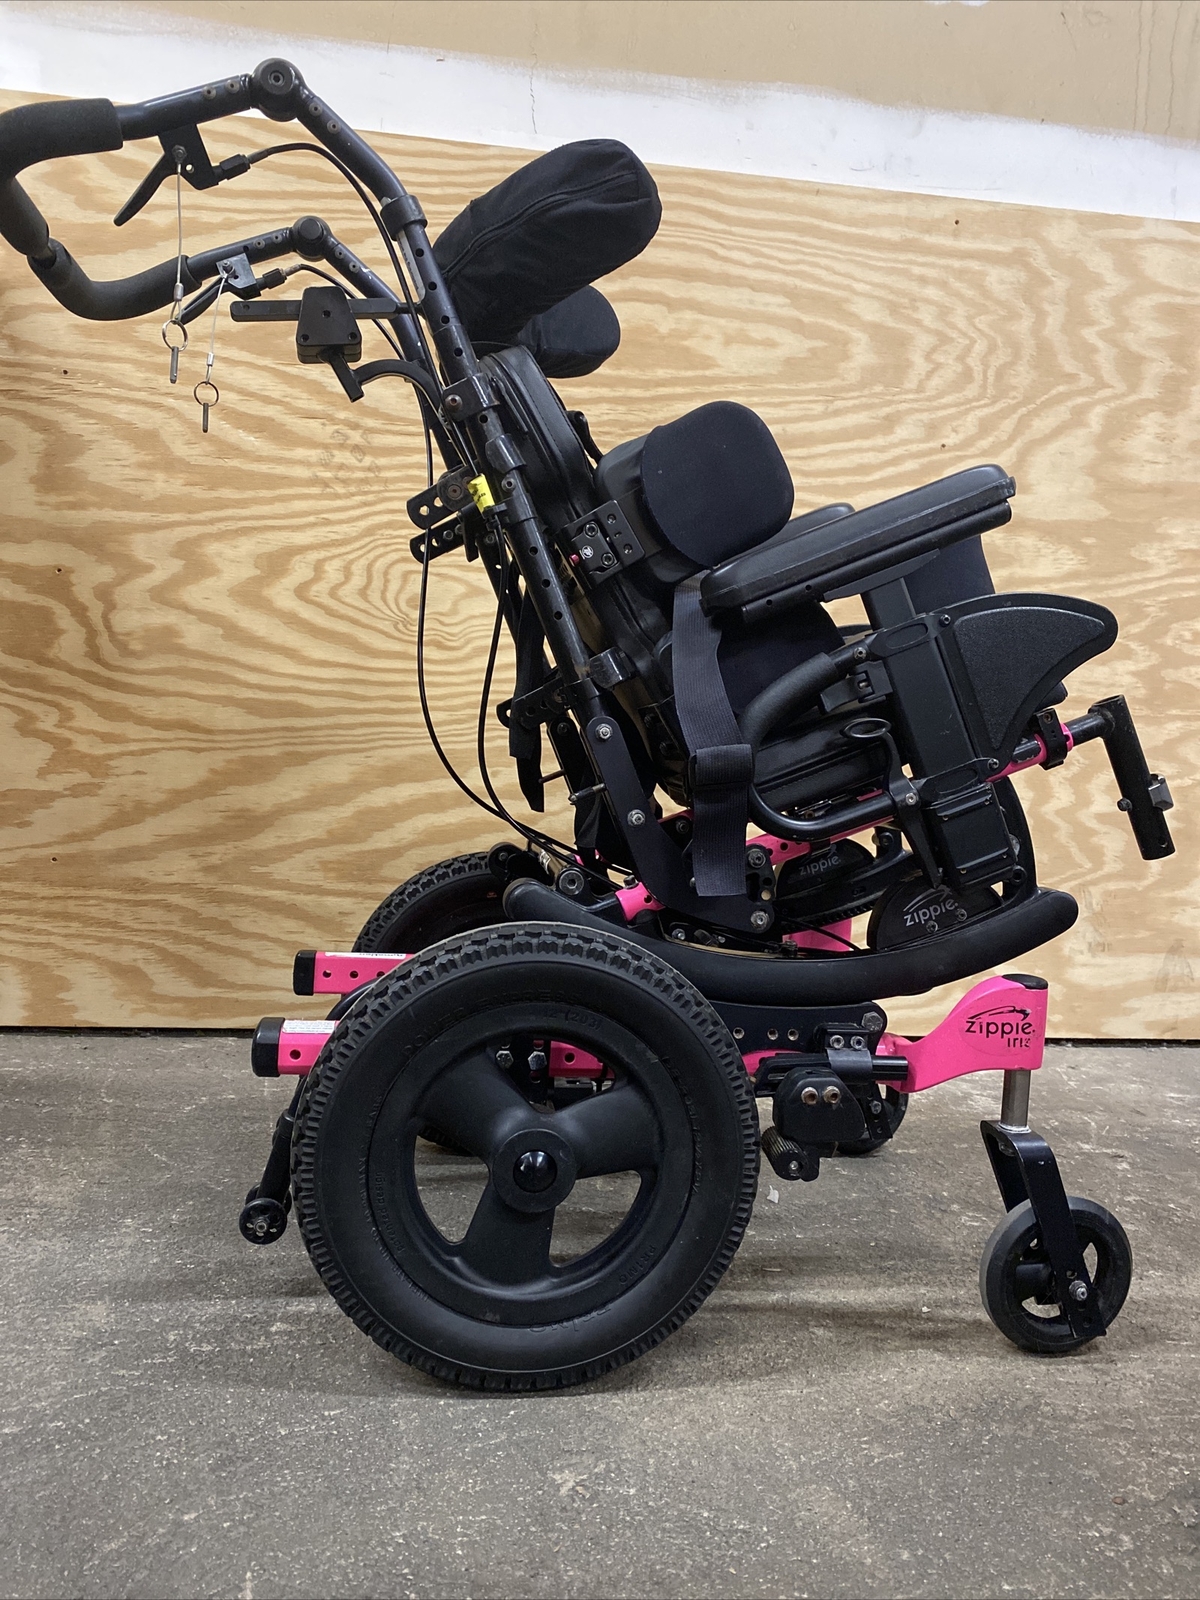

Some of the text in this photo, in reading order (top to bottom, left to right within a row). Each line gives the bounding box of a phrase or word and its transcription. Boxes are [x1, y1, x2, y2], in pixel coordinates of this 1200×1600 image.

[799, 854, 840, 876] zippie
[903, 899, 958, 927] zippie
[965, 1020, 1034, 1039] zippie
